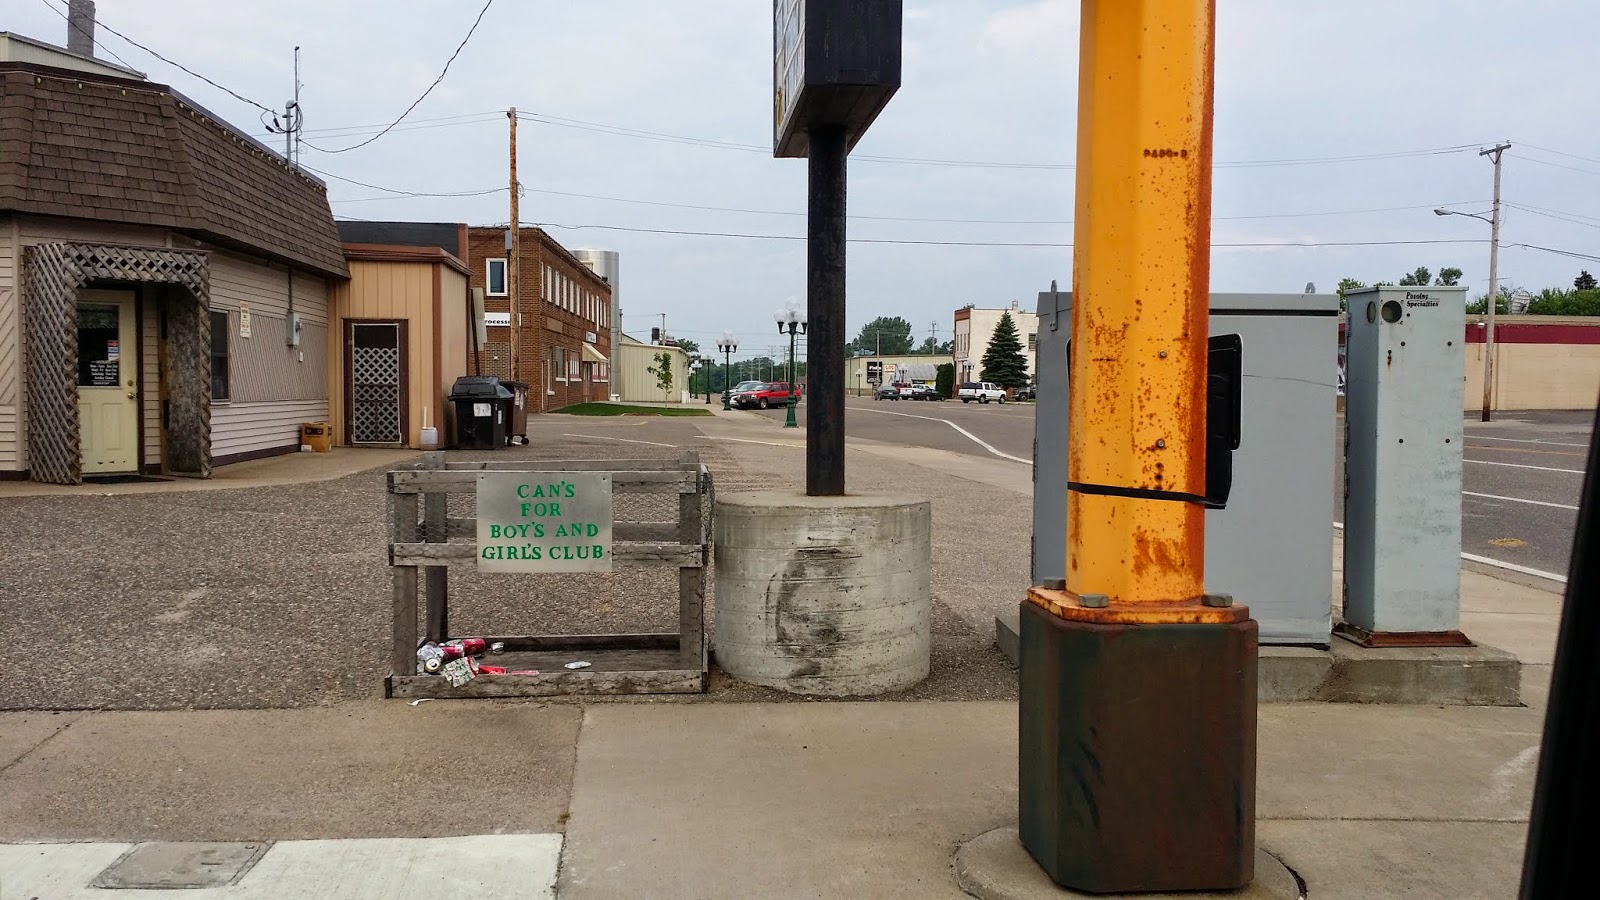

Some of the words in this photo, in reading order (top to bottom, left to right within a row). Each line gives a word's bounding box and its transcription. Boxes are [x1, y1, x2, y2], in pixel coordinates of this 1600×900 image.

[517, 481, 575, 498] CAN'S
[521, 503, 561, 517] FOR
[490, 522, 545, 538] BOY'S
[555, 523, 599, 537] AND
[482, 543, 542, 560] GIRL'S
[548, 545, 604, 560] CLUB
